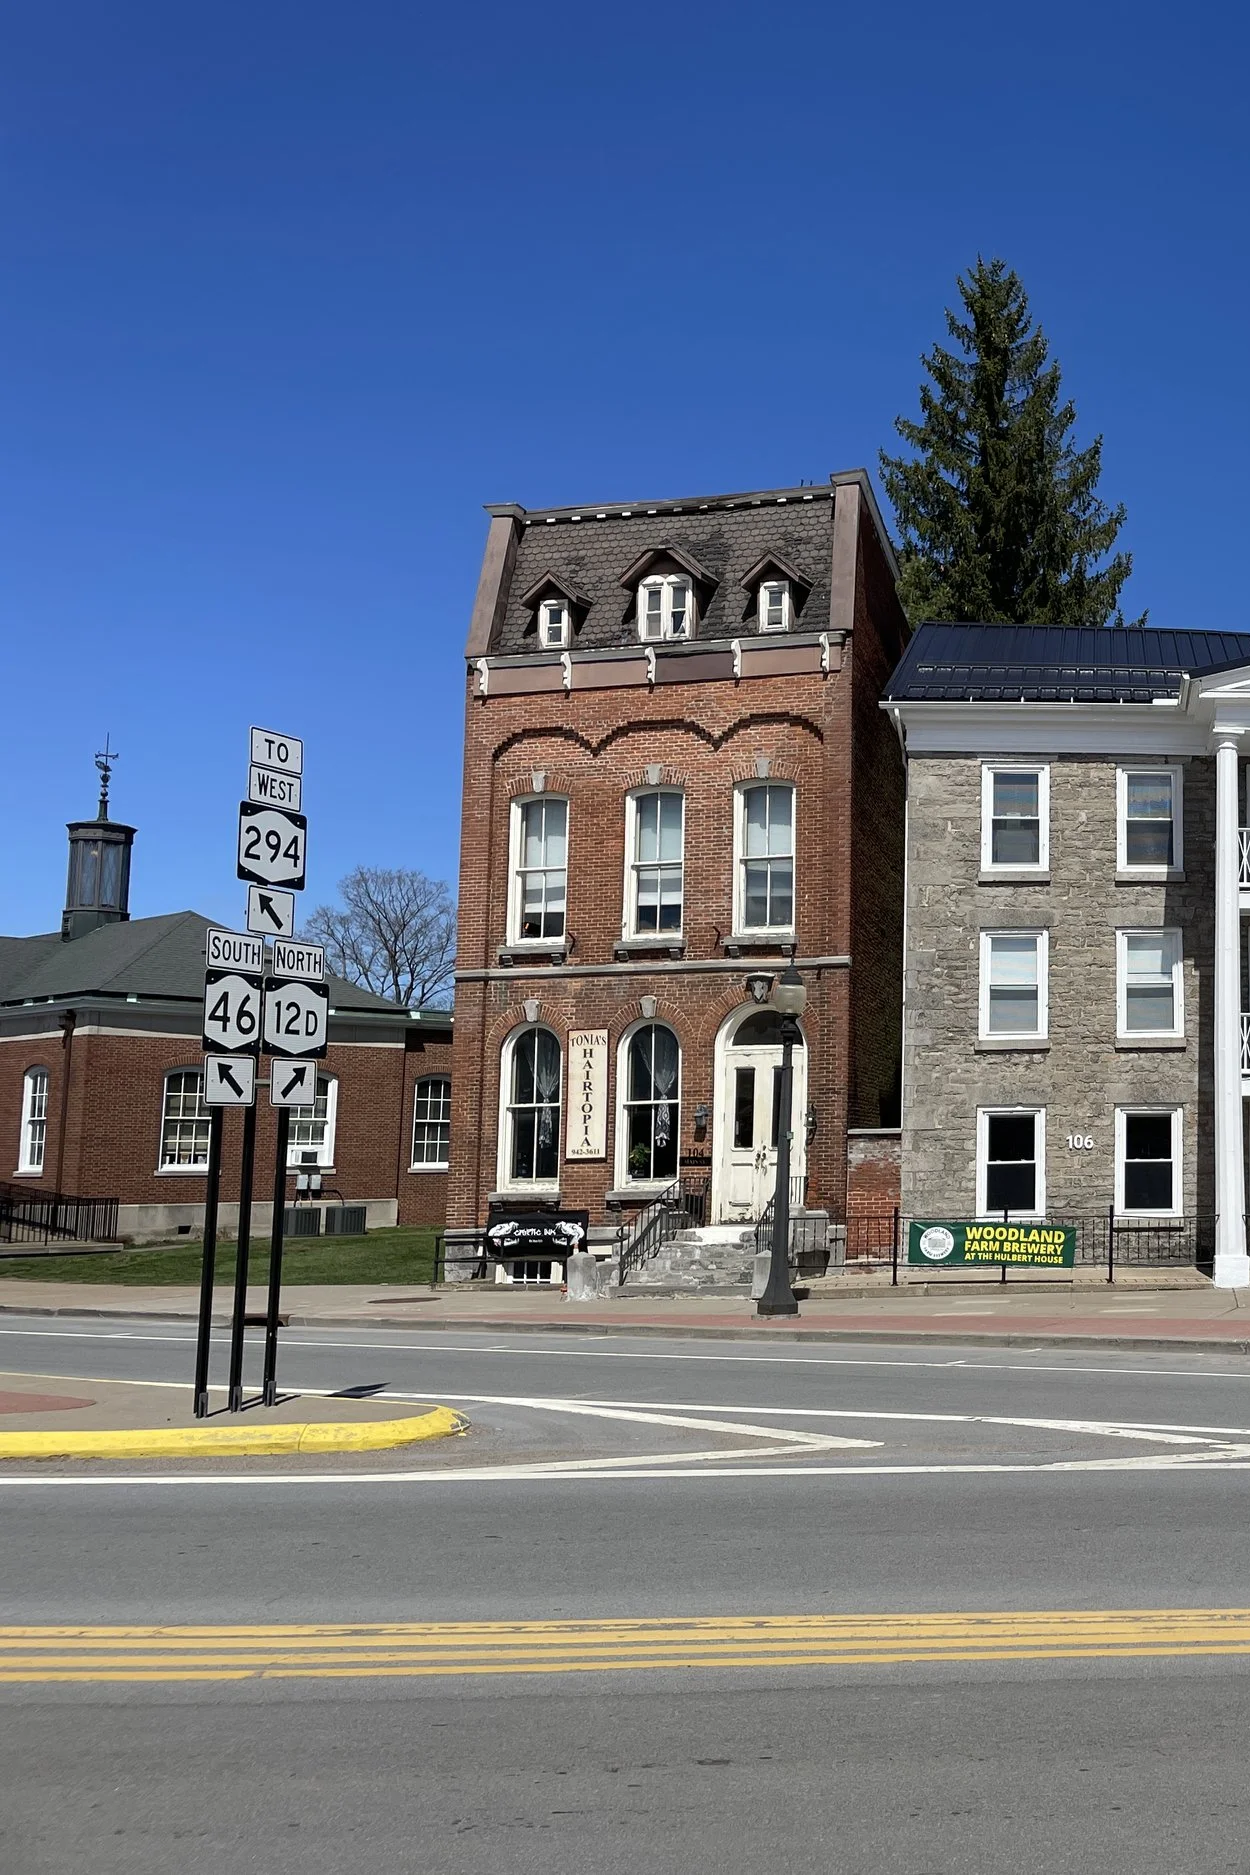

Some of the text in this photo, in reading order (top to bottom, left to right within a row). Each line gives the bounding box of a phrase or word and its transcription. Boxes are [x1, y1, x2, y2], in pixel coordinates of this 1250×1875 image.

[264, 738, 289, 763] TO
[257, 772, 294, 802] WEST
[244, 825, 300, 868] 294
[211, 936, 261, 965] SOUTH
[276, 946, 322, 974] NORTH
[208, 991, 256, 1035] 46
[275, 1000, 318, 1036] 12D
[571, 1034, 607, 1047] TONIA'S
[581, 1048, 593, 1147] HAIRTOPIA
[687, 1148, 704, 1157] 104
[1066, 1134, 1094, 1149] 106
[964, 1240, 1064, 1256] FARM BREWERY
[965, 1227, 1066, 1243] WOODLAND
[994, 1253, 1033, 1263] HULBERT
[1034, 1255, 1064, 1264] HOUSE
